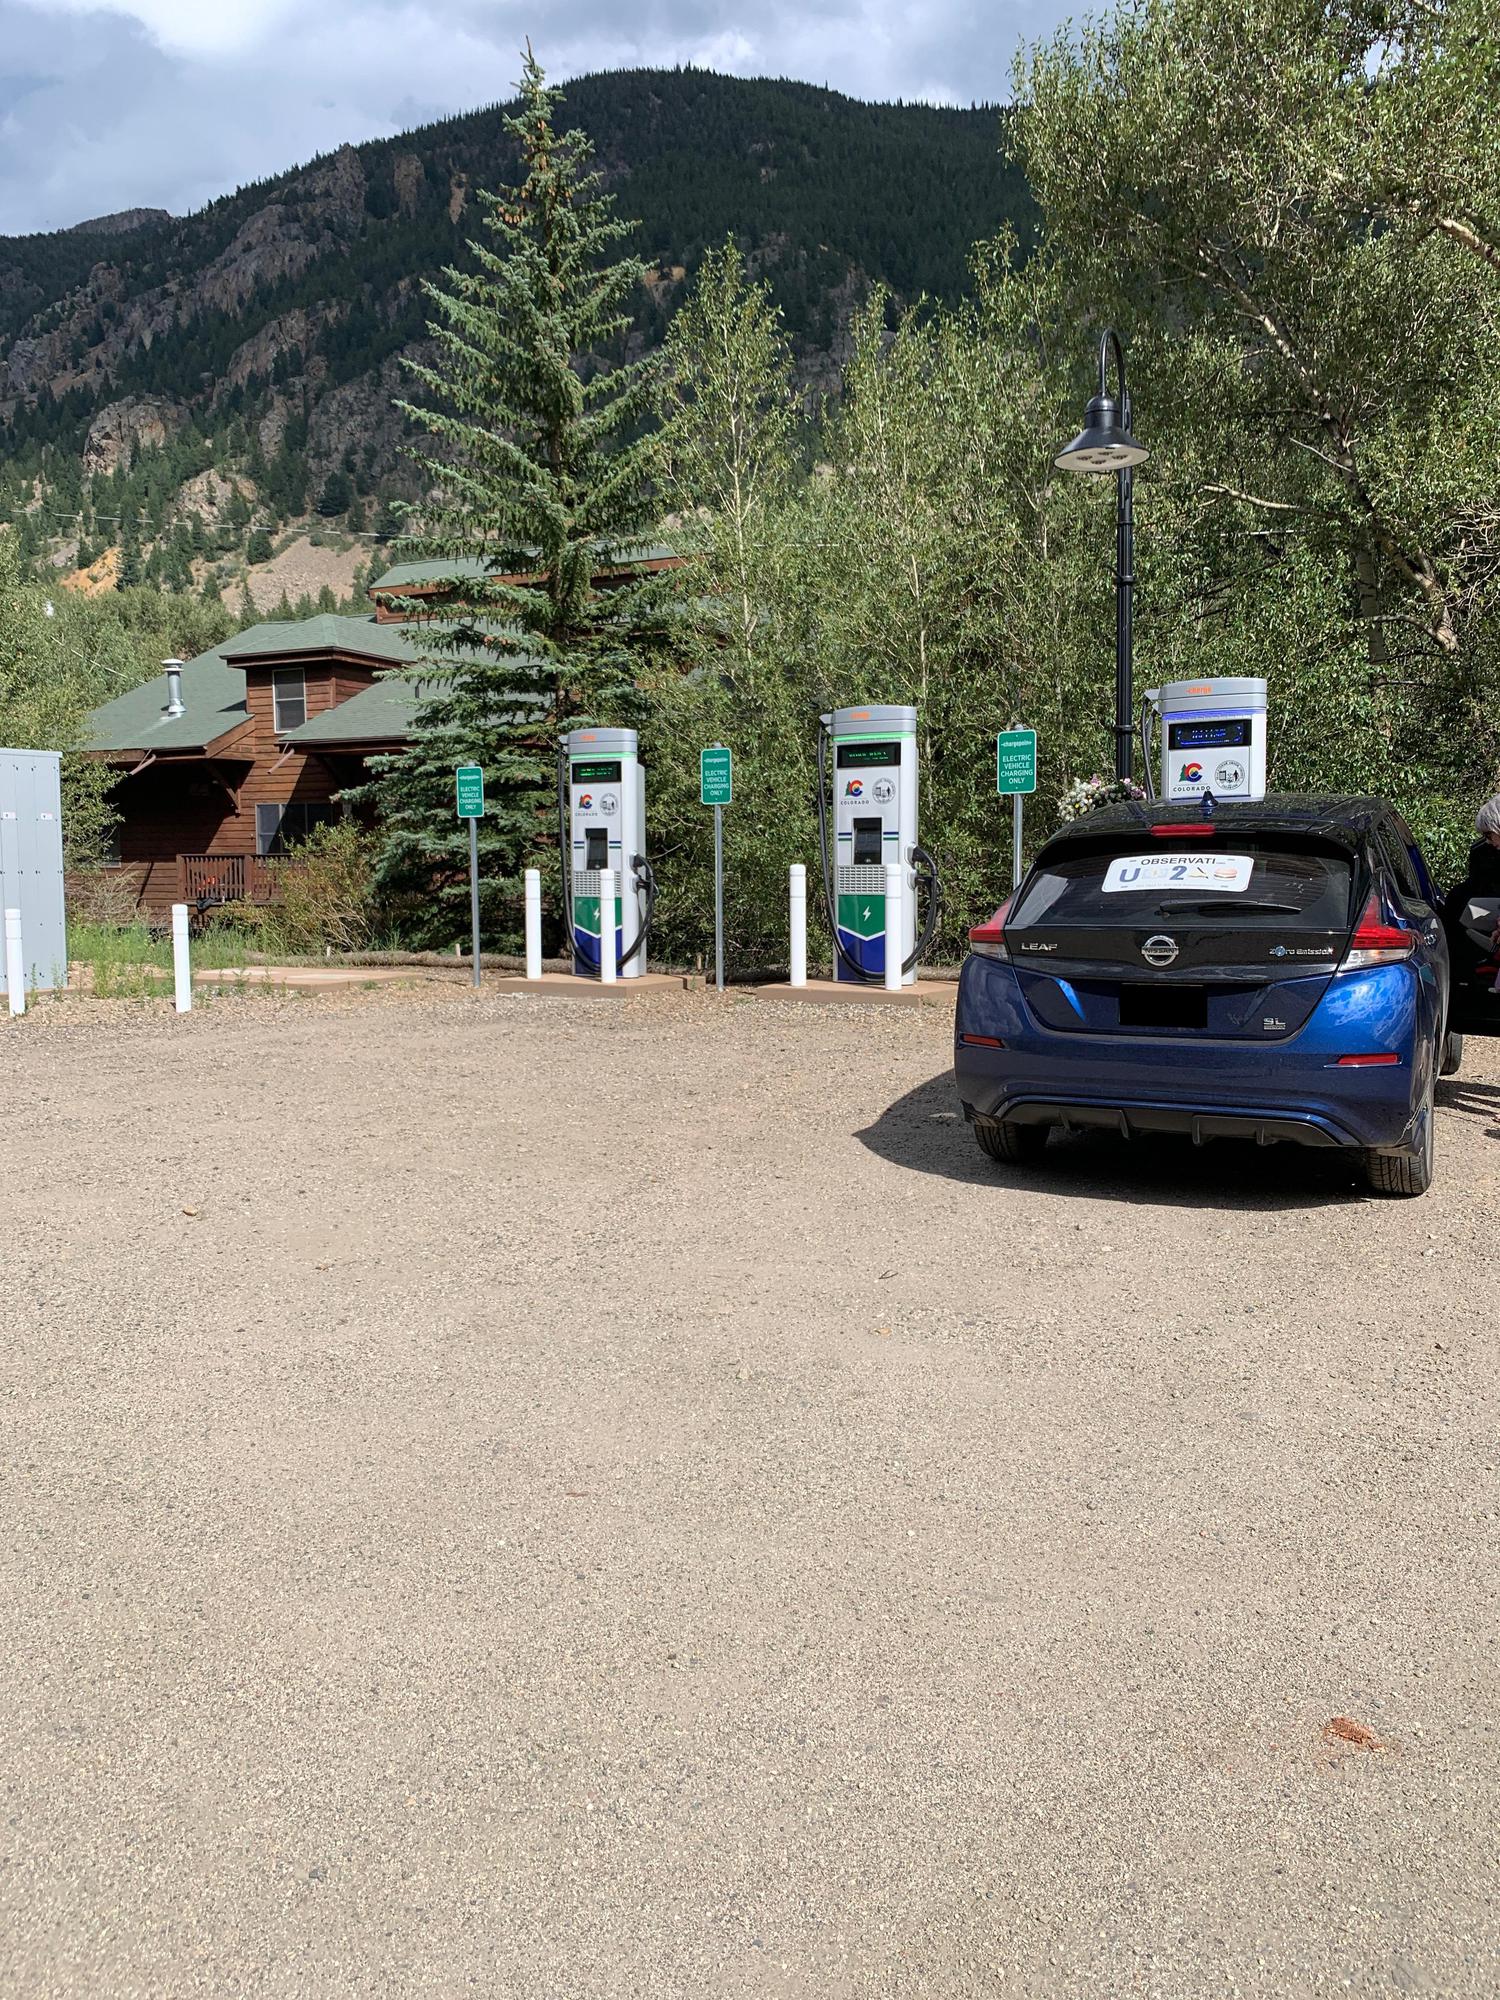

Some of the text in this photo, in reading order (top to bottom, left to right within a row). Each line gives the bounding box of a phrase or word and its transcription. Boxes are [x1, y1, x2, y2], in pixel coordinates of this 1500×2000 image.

[1002, 754, 1032, 762] ELECTRIC
[1000, 769, 1034, 777] CHARGING
[1008, 777, 1026, 785] ONLY
[1172, 785, 1211, 793] COLORADO
[1140, 857, 1217, 865] OBSERVATI
[1119, 865, 1188, 883] U 2
[1021, 942, 1058, 951] LEAF
